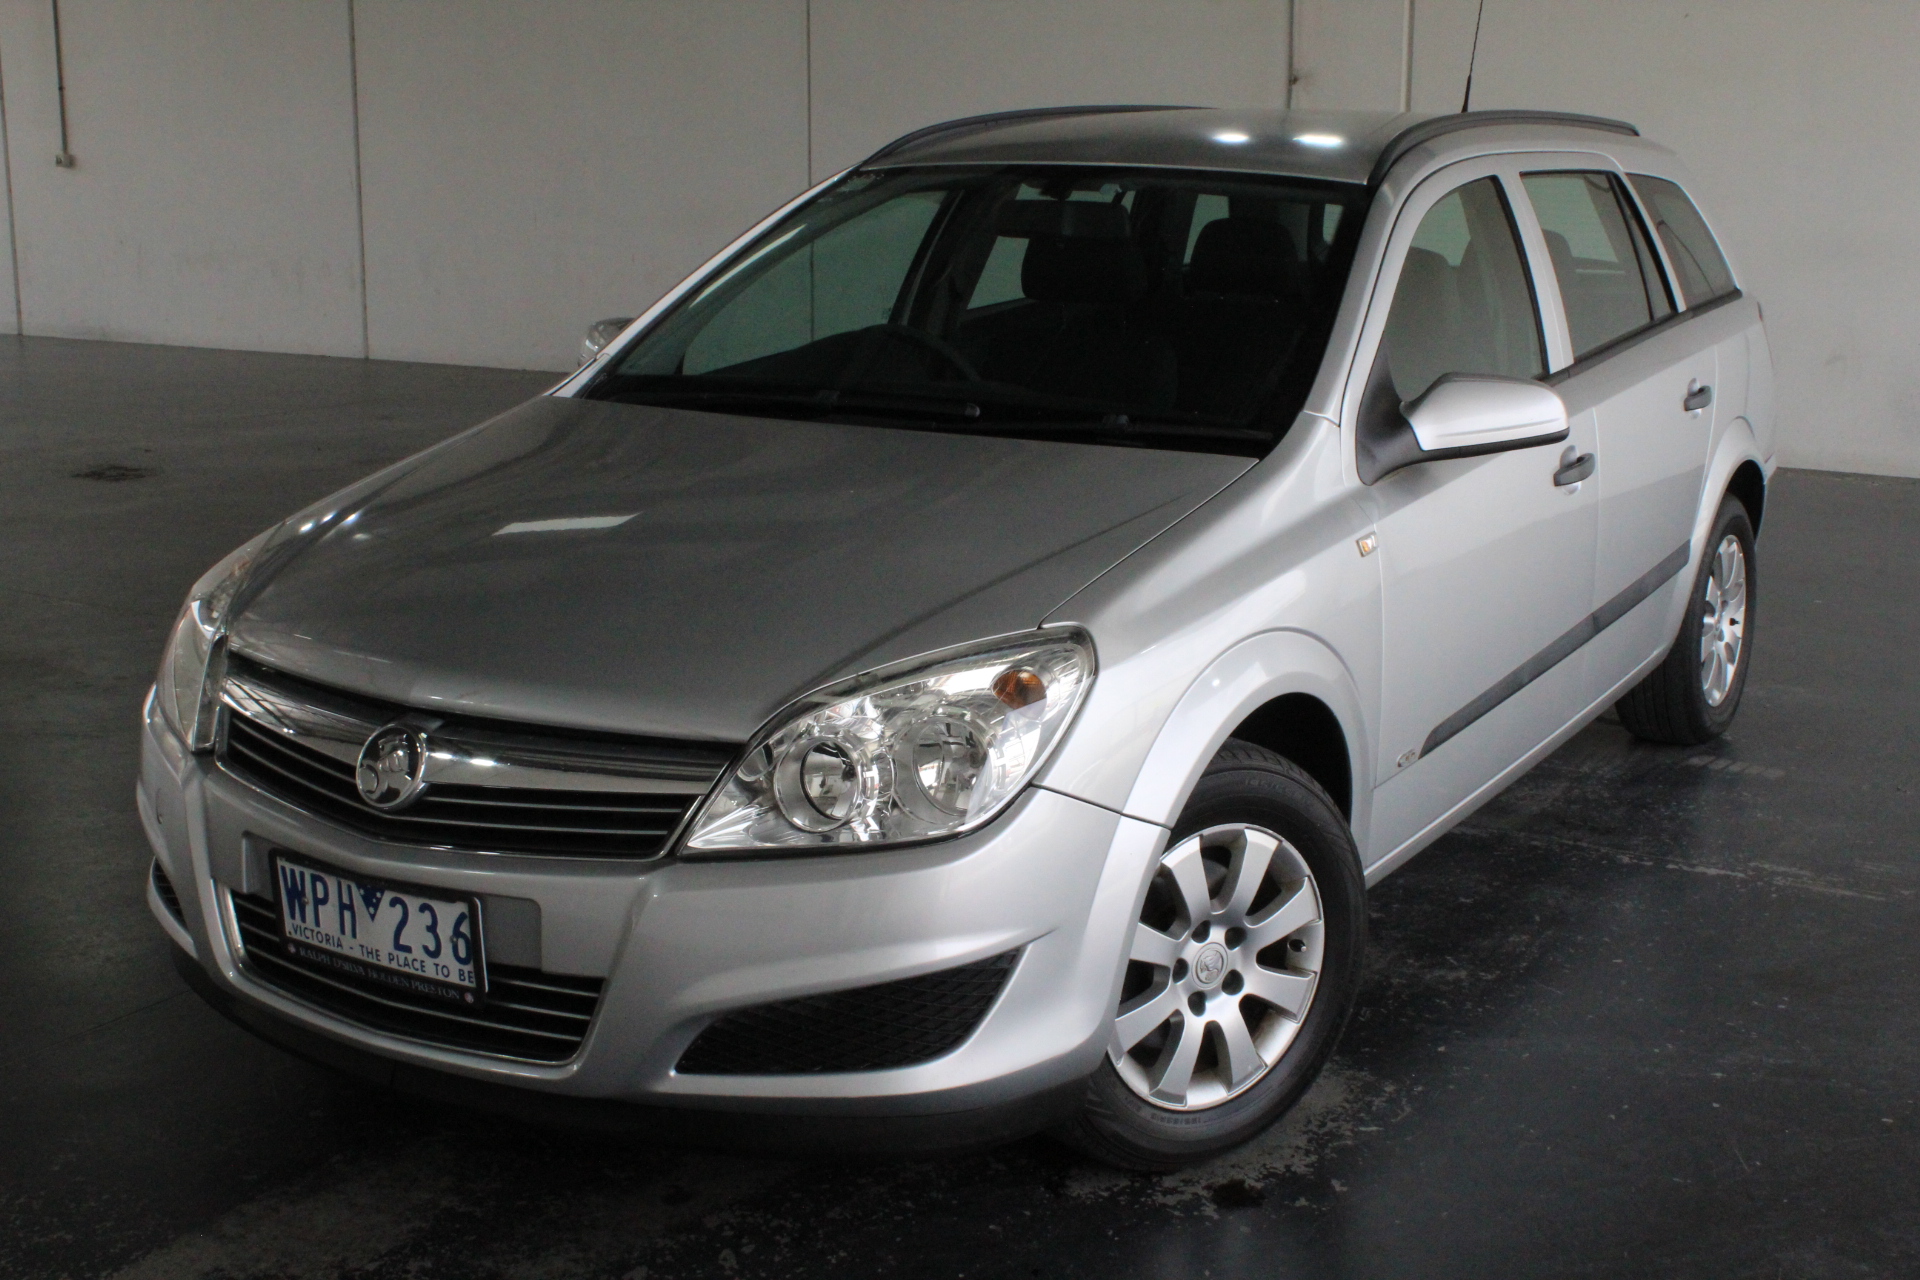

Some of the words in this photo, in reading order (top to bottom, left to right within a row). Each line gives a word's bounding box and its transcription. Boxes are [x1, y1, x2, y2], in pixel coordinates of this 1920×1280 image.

[280, 865, 358, 939] WPH
[388, 896, 473, 965] 236
[291, 923, 344, 950] VICTORIA
[359, 944, 382, 962] THE
[387, 952, 427, 974] PLACE
[433, 963, 451, 978] TO
[458, 971, 475, 984] BE
[299, 948, 331, 965] RALPH
[411, 979, 460, 999] PRESTON
